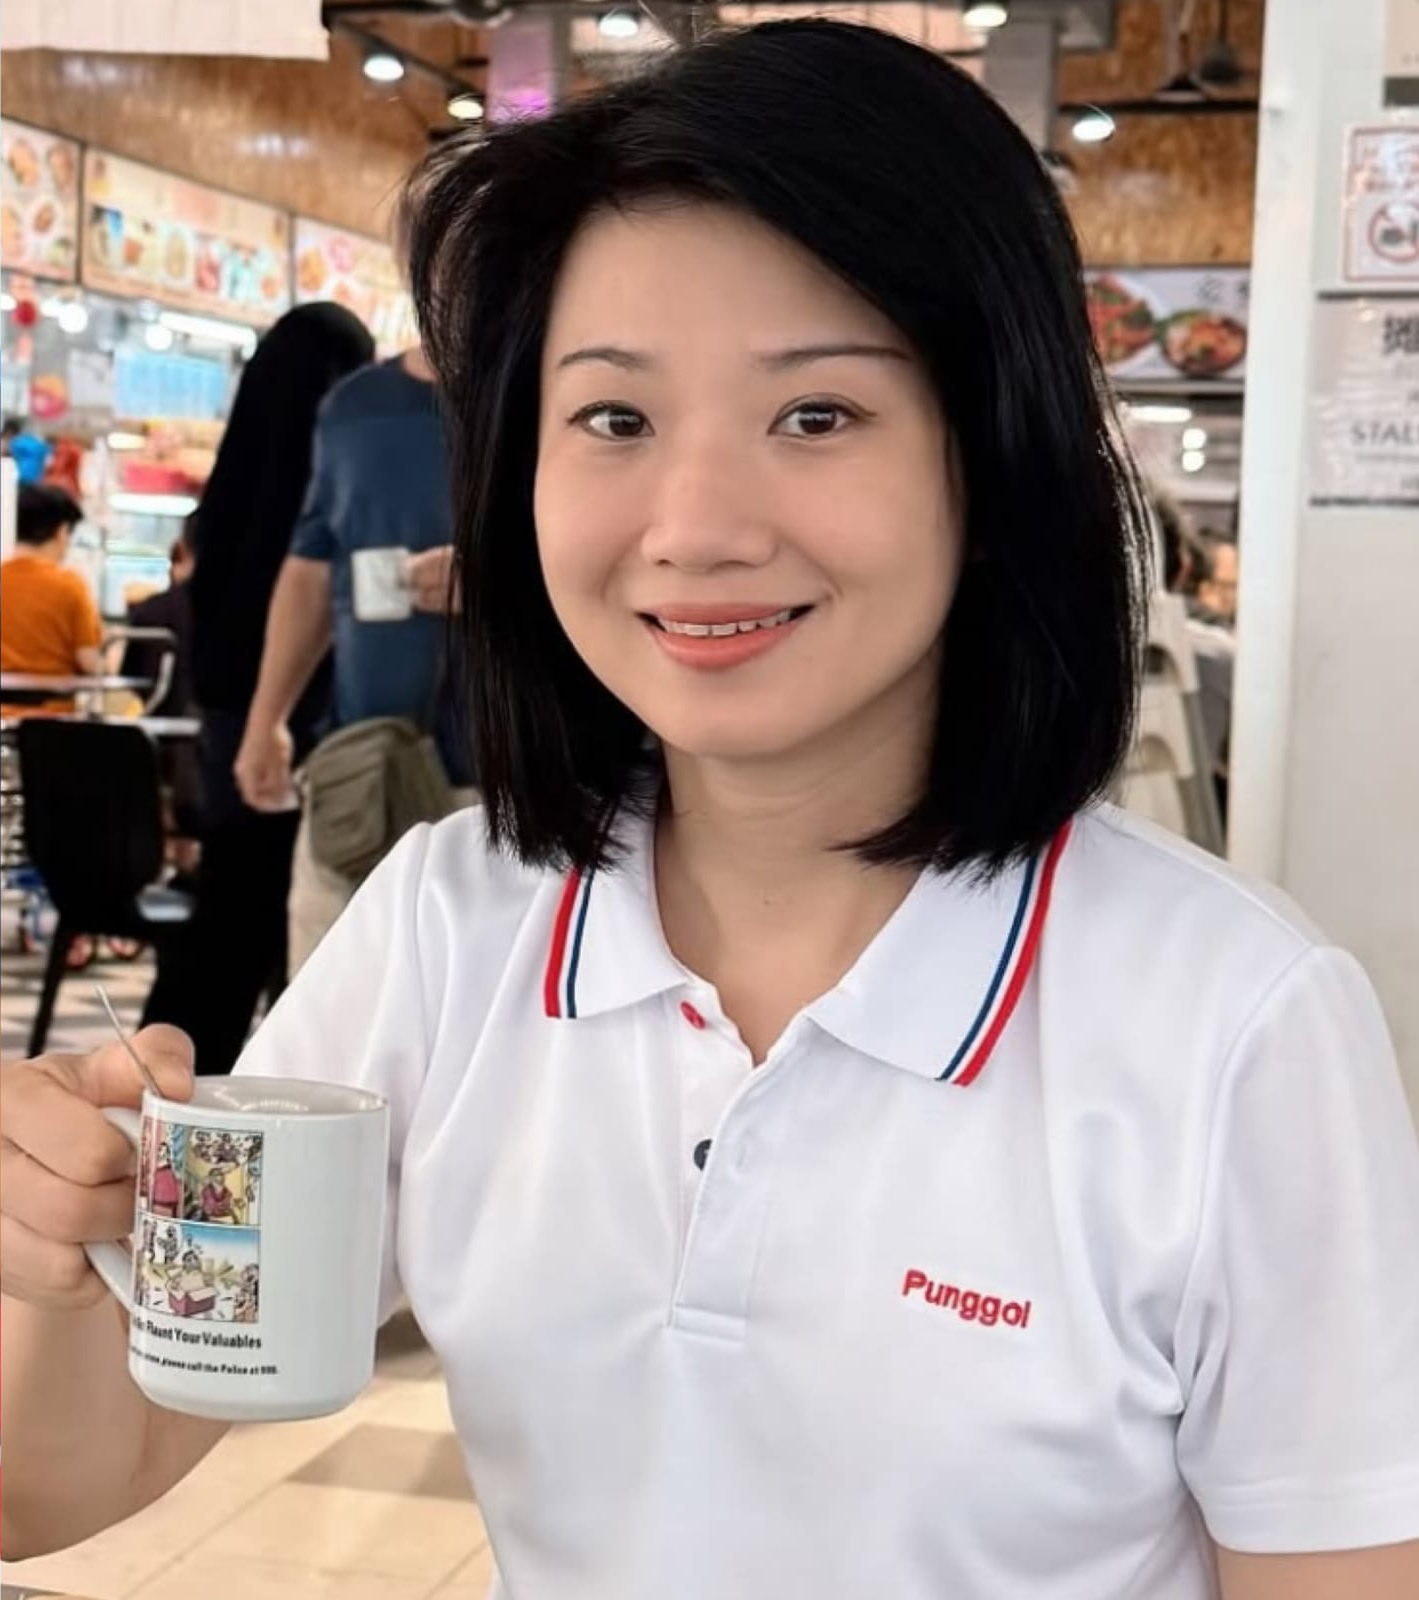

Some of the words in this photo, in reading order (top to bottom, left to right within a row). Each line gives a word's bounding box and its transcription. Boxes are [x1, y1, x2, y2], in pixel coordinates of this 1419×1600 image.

[1351, 419, 1419, 446] STAL
[902, 1268, 1032, 1329] Punggol
[174, 1327, 200, 1345] Your
[202, 1331, 262, 1349] Valuables
